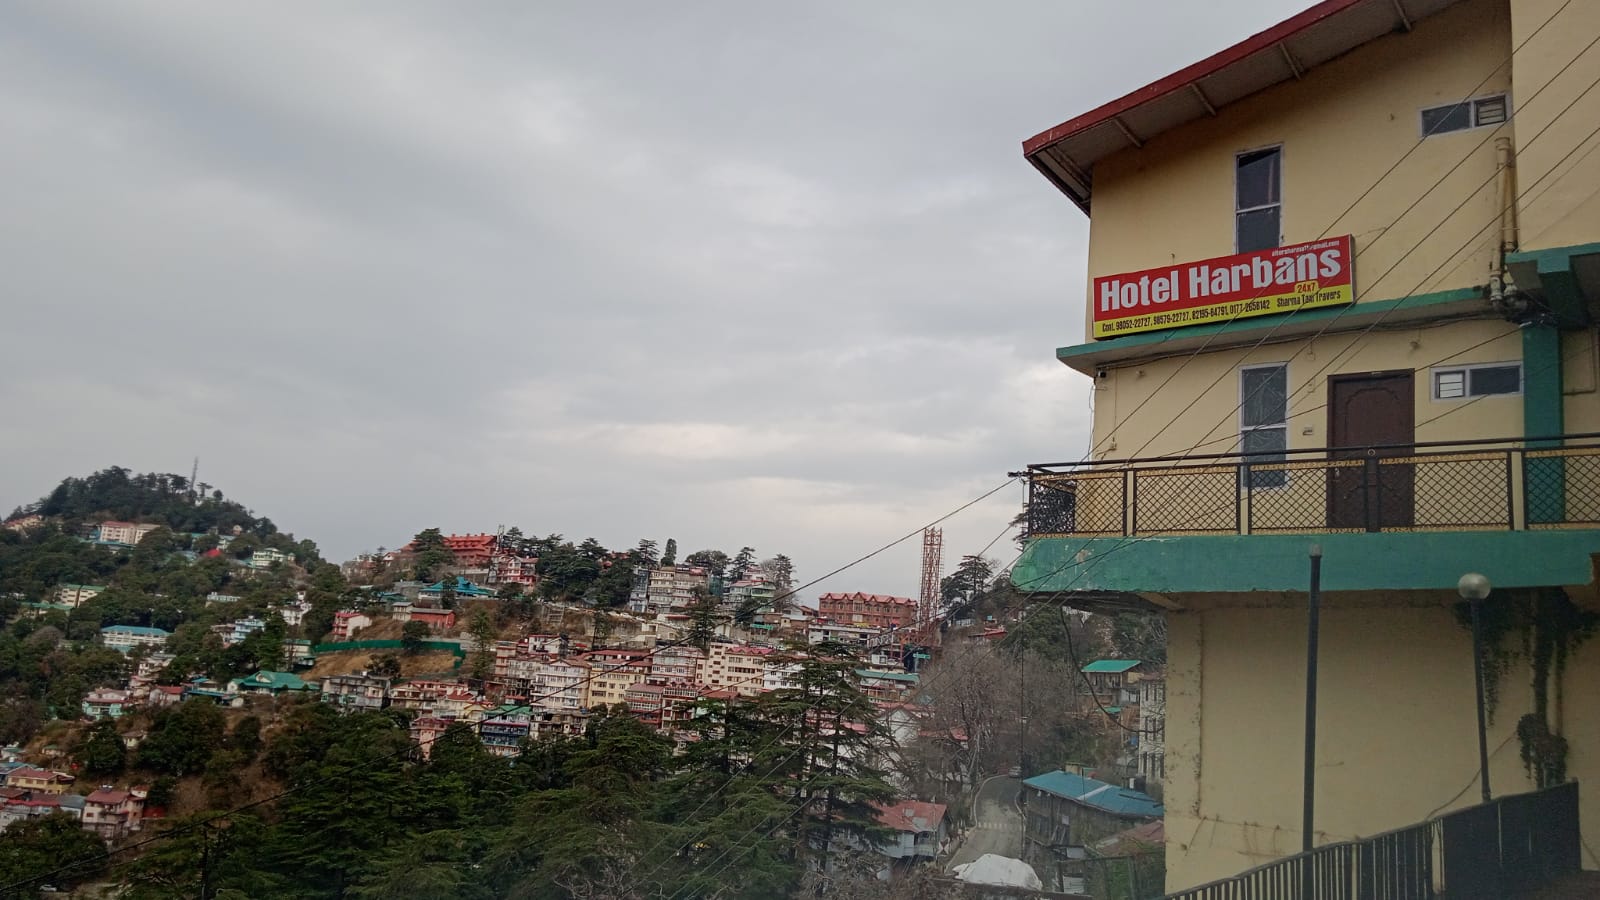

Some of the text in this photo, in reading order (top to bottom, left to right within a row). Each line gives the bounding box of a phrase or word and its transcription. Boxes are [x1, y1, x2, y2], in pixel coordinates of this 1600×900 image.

[1101, 249, 1342, 312] Hotel Harbans
[1297, 282, 1316, 294] 24x7
[1277, 296, 1301, 308] Sharma
